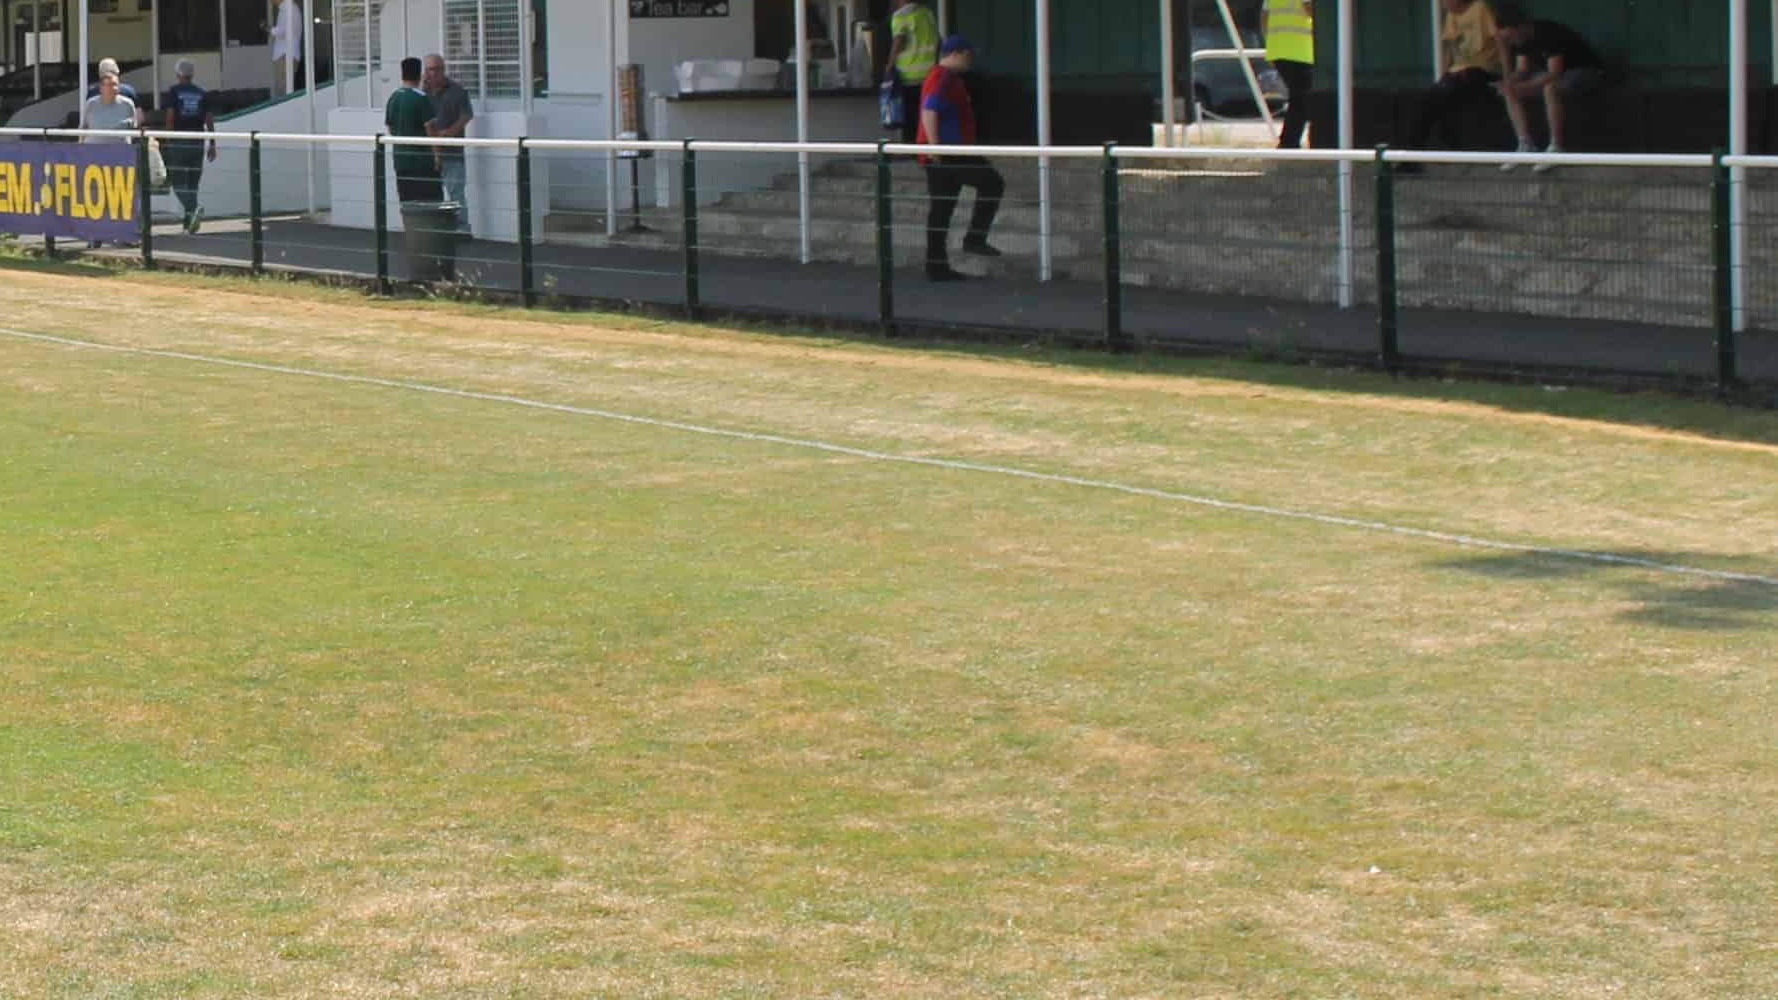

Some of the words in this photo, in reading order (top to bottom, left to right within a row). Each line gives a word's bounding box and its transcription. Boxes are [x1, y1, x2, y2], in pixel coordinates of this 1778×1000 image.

[648, 0, 673, 16] Tea
[677, 0, 703, 16] bar
[54, 163, 136, 221] FLOW
